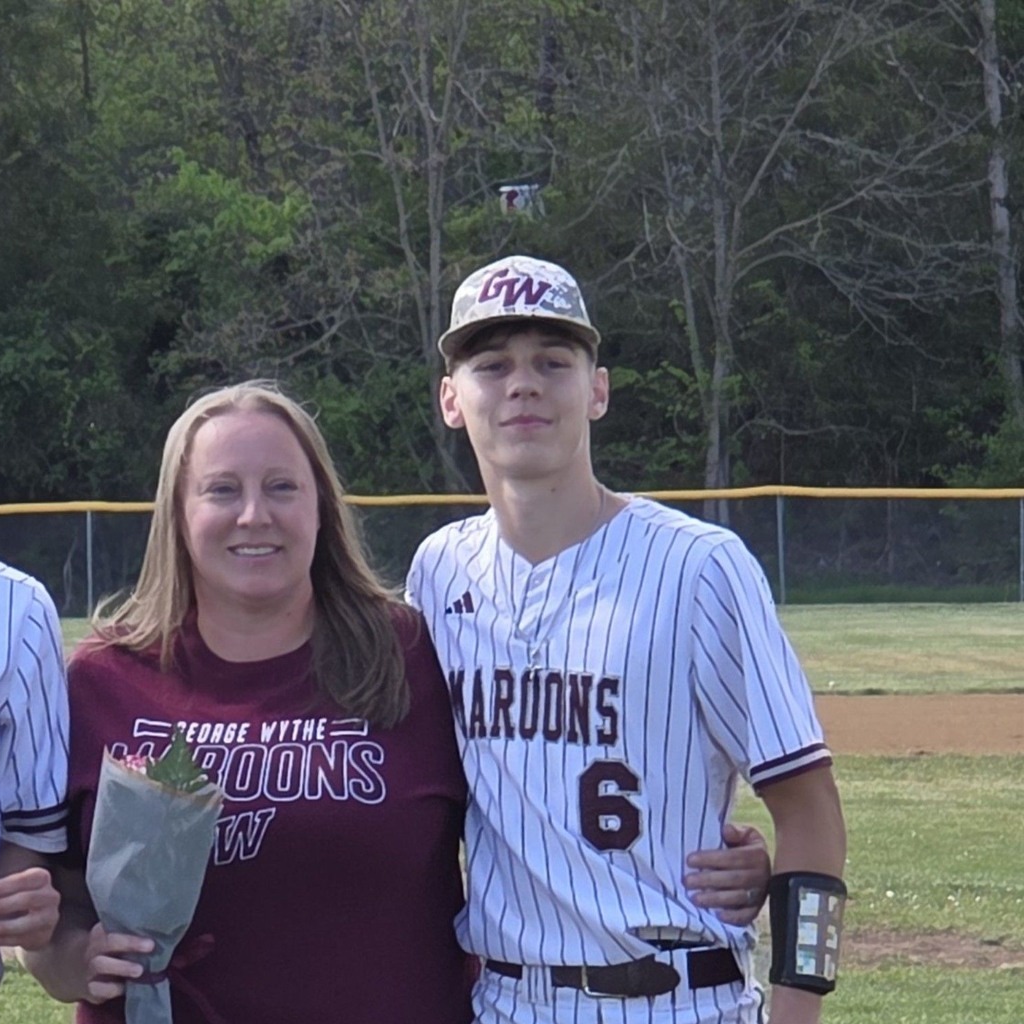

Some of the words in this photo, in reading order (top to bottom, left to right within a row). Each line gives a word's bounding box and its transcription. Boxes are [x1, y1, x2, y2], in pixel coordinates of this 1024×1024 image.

[478, 268, 552, 307] GW
[260, 718, 327, 743] WYTHE
[110, 740, 387, 805] ROONS
[578, 758, 643, 852] 6
